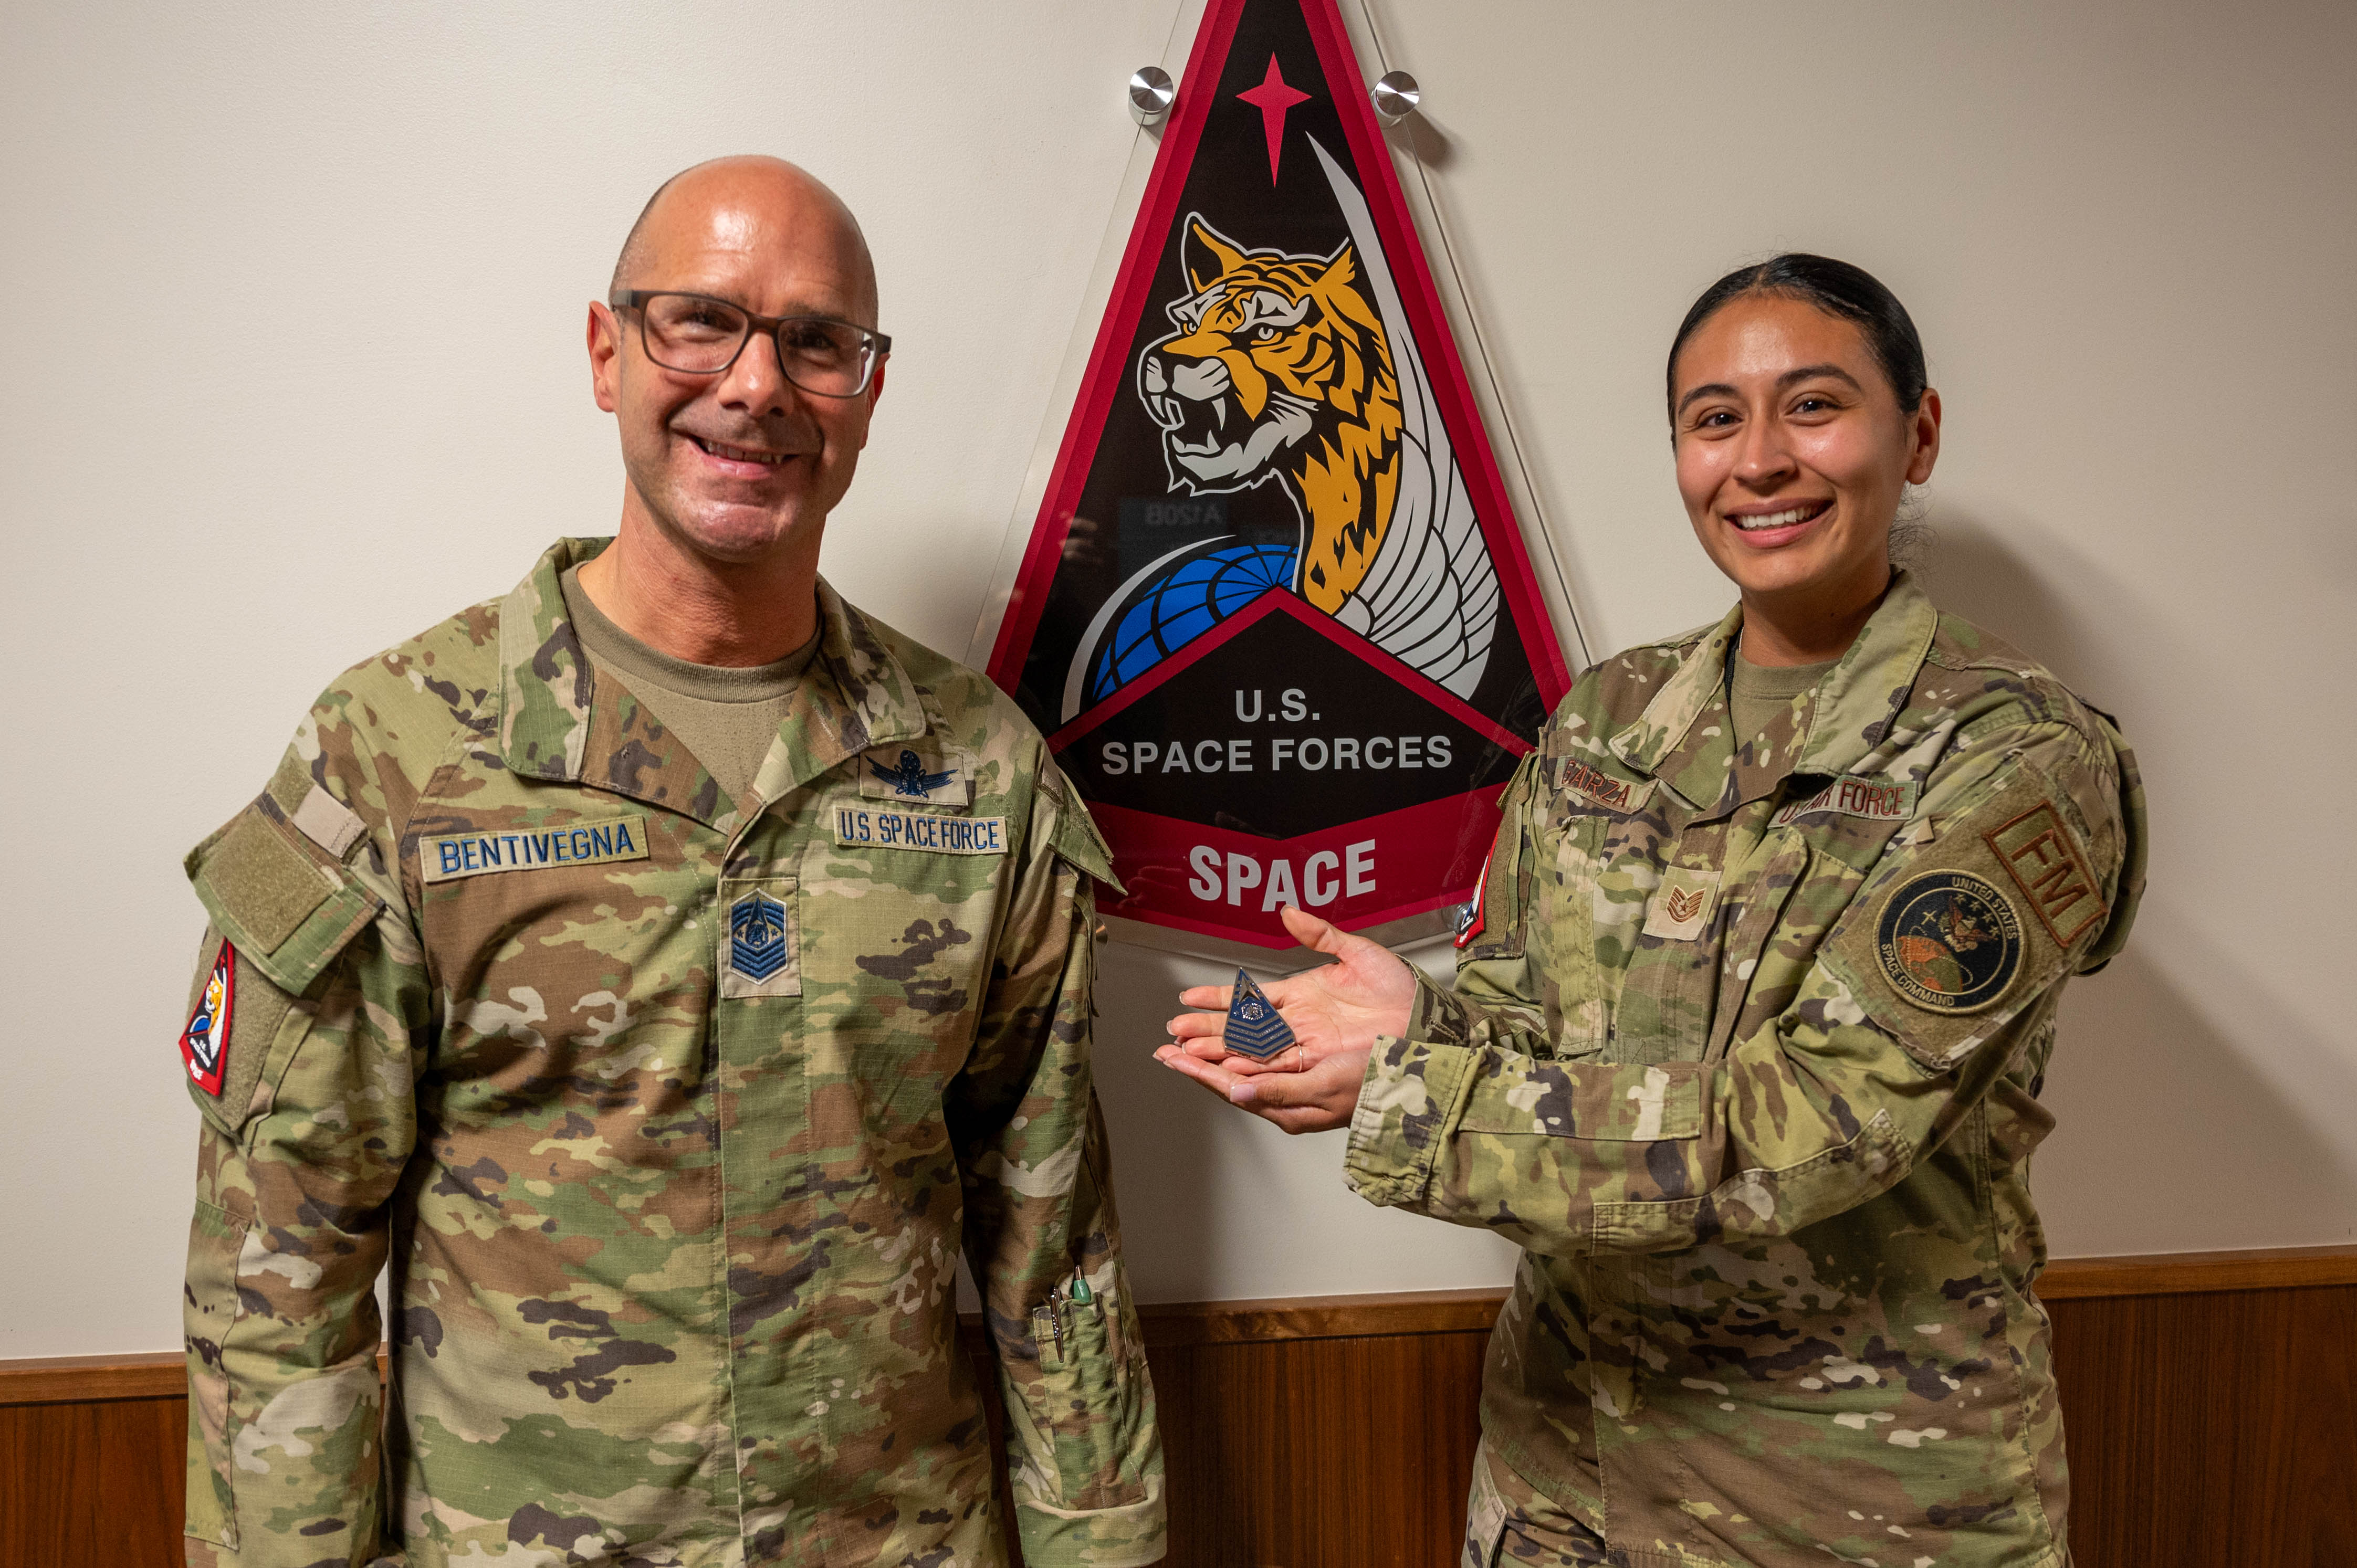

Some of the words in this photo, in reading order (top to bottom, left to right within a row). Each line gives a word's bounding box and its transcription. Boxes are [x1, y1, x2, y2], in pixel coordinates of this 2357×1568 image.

[1235, 688, 1320, 722] U.S.
[1102, 739, 1253, 775] SPACE
[1272, 735, 1452, 771] FORCES
[1561, 760, 1631, 807] GARZA
[1839, 780, 1905, 817] FORCE
[438, 823, 636, 874] BENTIVEGNA
[841, 811, 875, 842] U.S.
[878, 814, 938, 847] SPACE
[940, 820, 1000, 850] FORCE
[1189, 838, 1376, 912] SPACE
[2010, 829, 2090, 920] FM
[1951, 876, 1993, 900] UNITED
[1992, 899, 2018, 940] STATES
[1881, 943, 1900, 980] SPACE
[1897, 975, 1955, 1006] COMMAND
